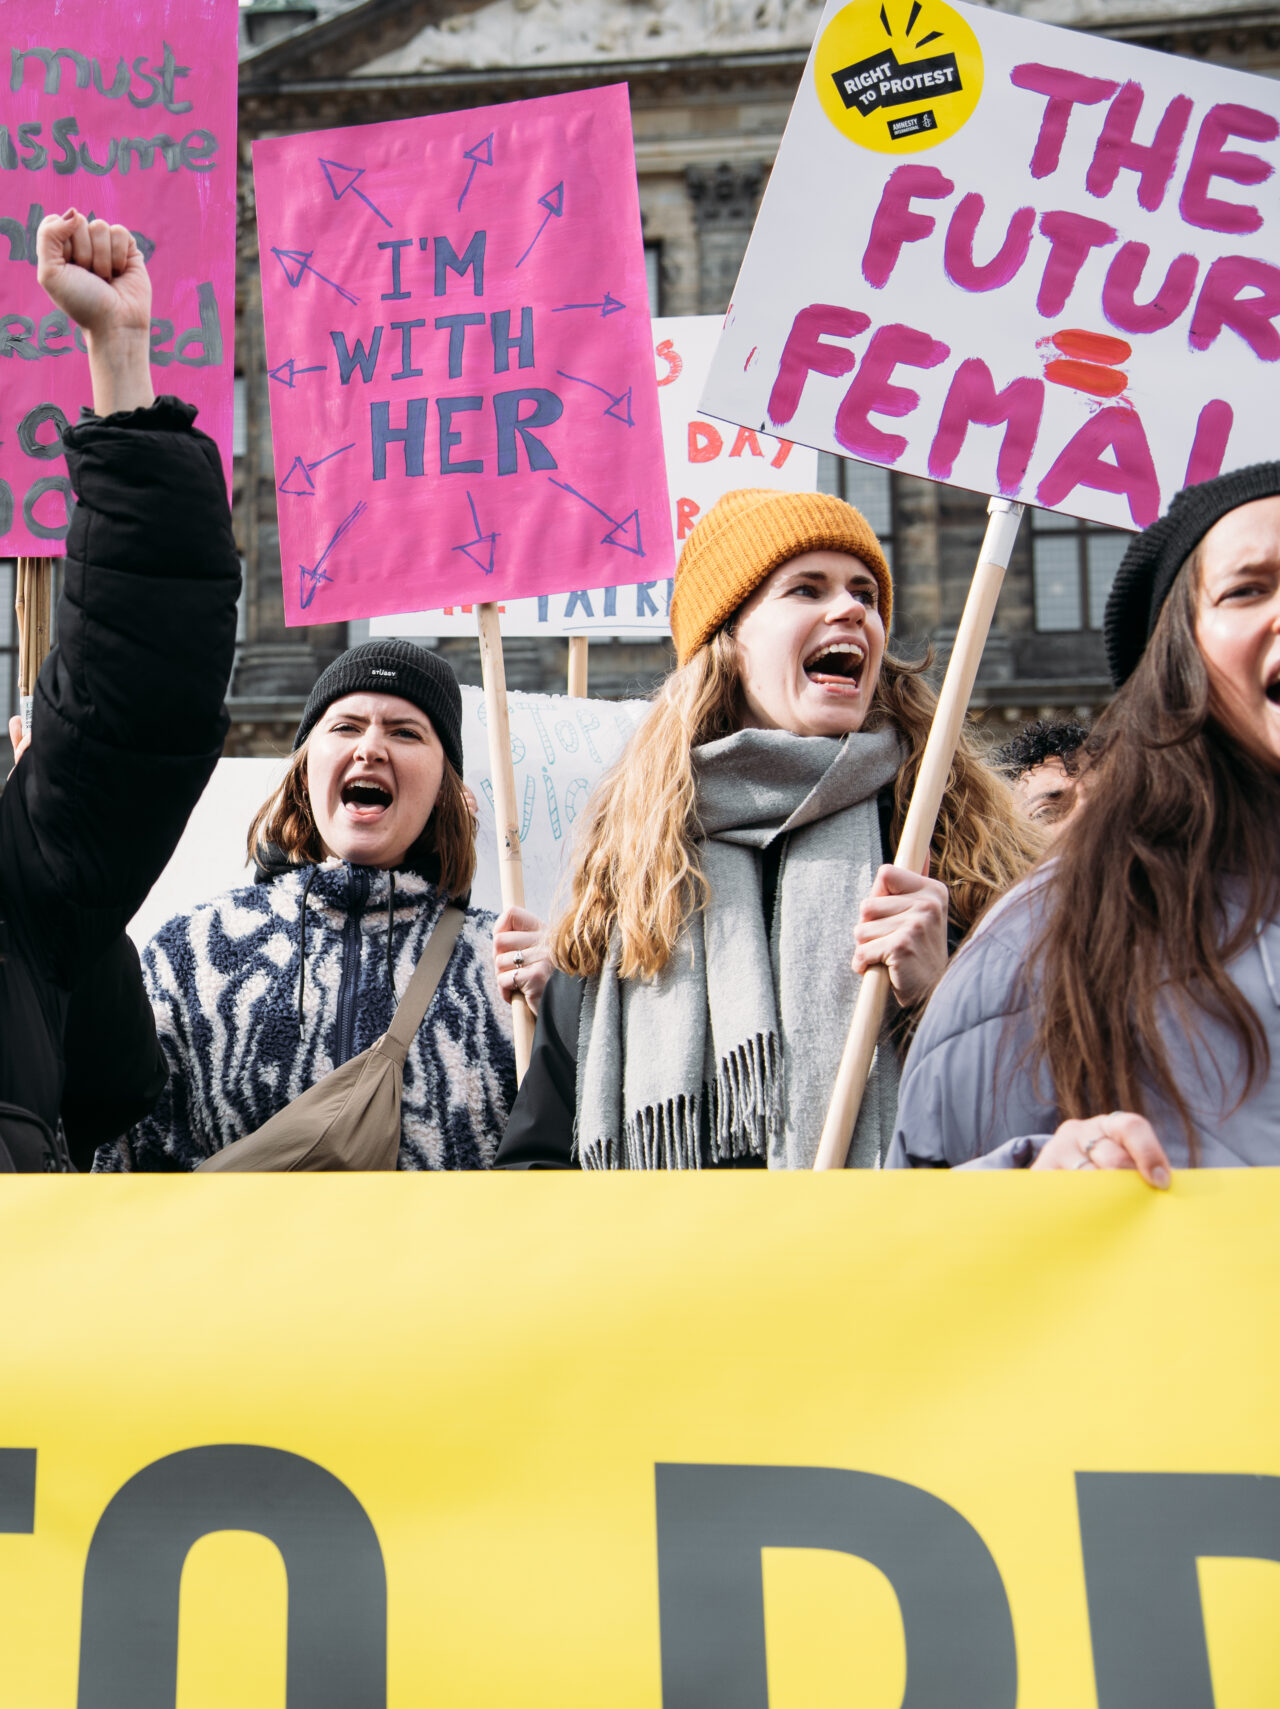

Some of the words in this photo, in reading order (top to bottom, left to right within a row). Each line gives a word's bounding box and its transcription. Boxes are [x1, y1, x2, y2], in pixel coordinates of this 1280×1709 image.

[10, 40, 193, 114] must
[843, 62, 892, 94] RIGHT
[859, 90, 877, 105] TO
[879, 67, 955, 96] PROTEST
[1009, 62, 1280, 235] THE
[378, 230, 486, 301] I'M
[330, 306, 535, 385] WITH
[370, 388, 564, 481] HER
